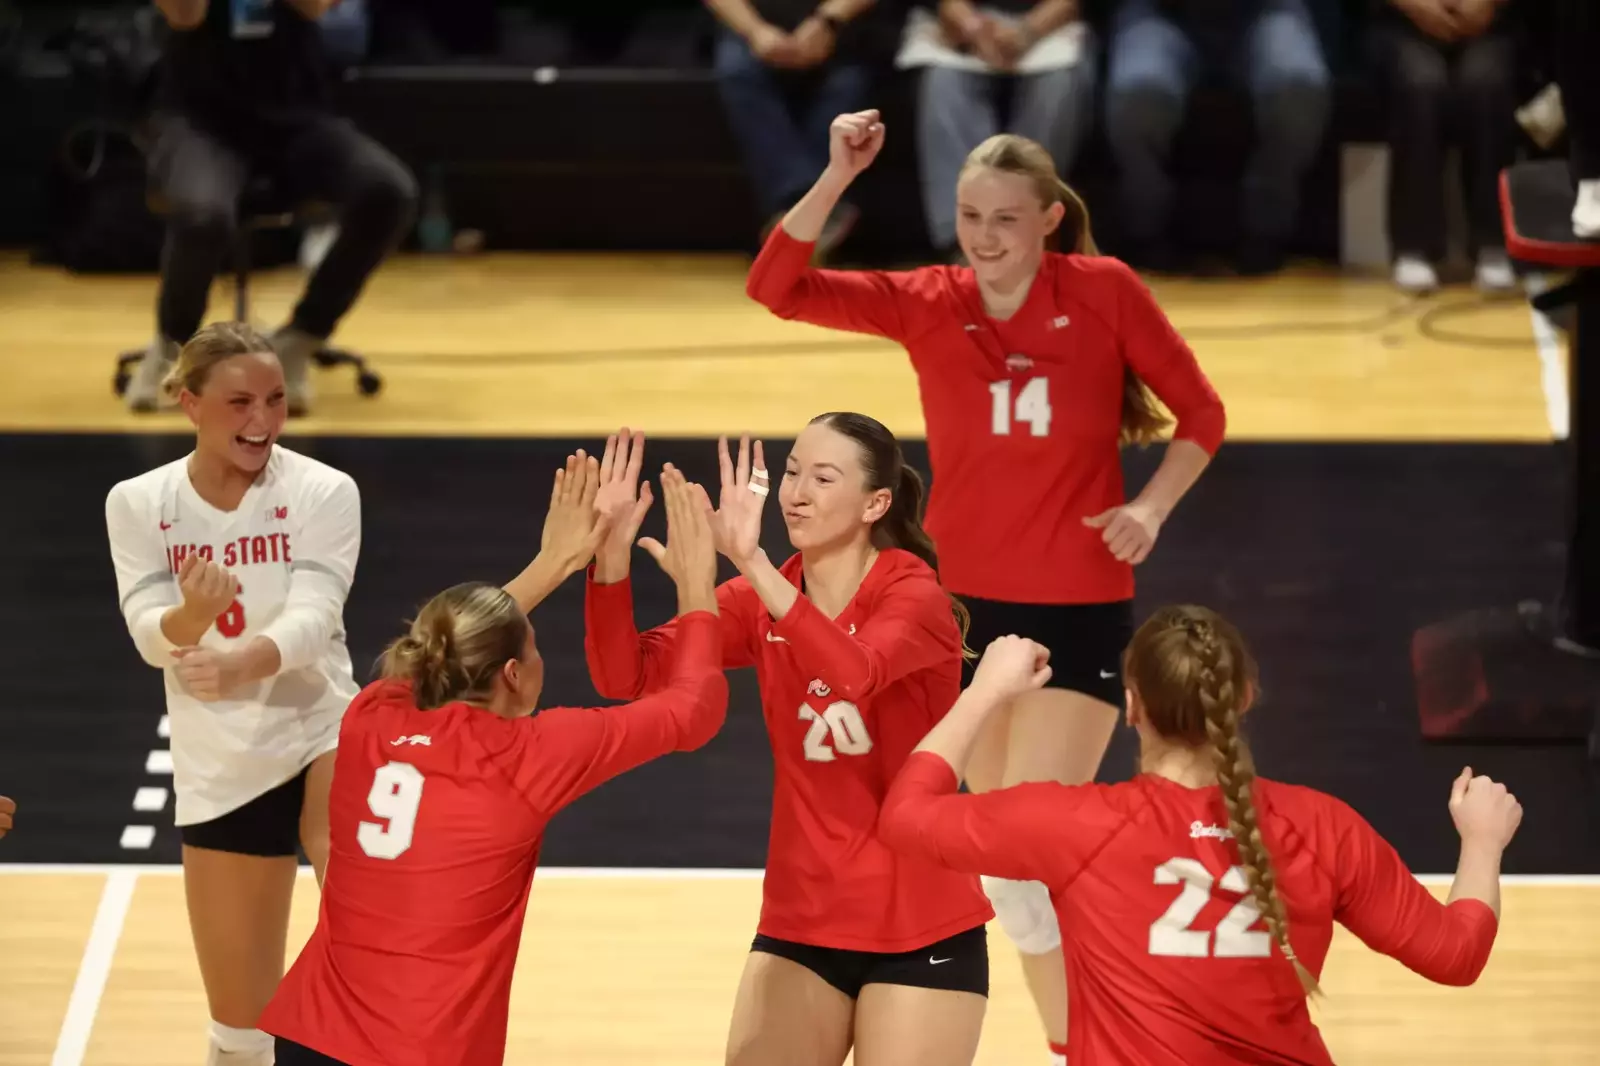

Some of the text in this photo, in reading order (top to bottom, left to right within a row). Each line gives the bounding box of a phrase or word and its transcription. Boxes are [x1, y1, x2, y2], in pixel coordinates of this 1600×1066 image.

[989, 376, 1052, 436] 14
[223, 532, 292, 567] STATE
[215, 583, 246, 639] 6
[798, 700, 873, 762] 20
[356, 760, 425, 860] 9
[1148, 857, 1271, 957] 22
